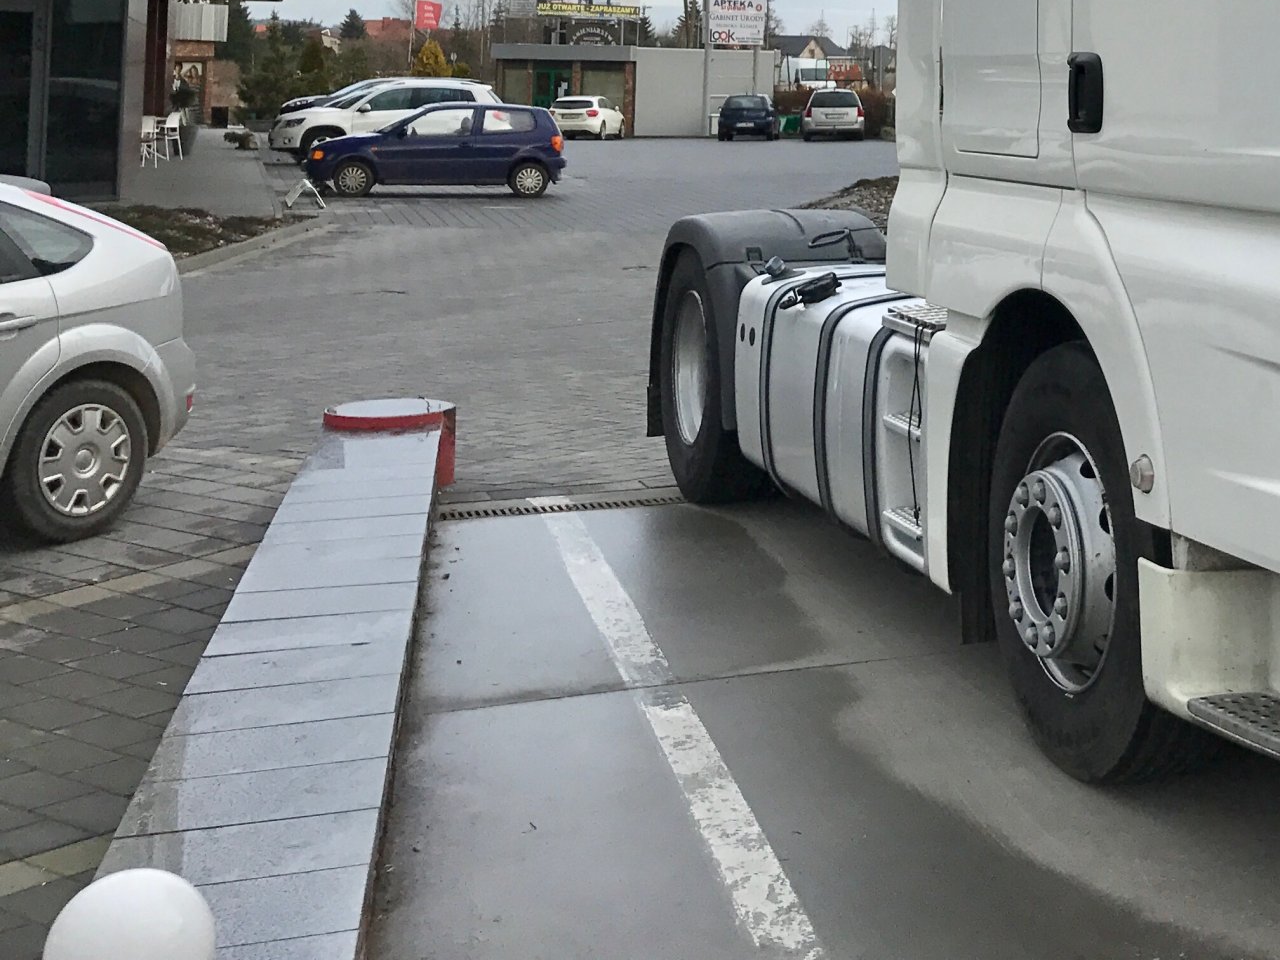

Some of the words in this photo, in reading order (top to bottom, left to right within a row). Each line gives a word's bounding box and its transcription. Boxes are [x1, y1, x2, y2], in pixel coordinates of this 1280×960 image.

[552, 3, 586, 12] OTWARTE
[590, 5, 636, 14] ZAPRASZAMY
[713, 0, 754, 9] APTEKA
